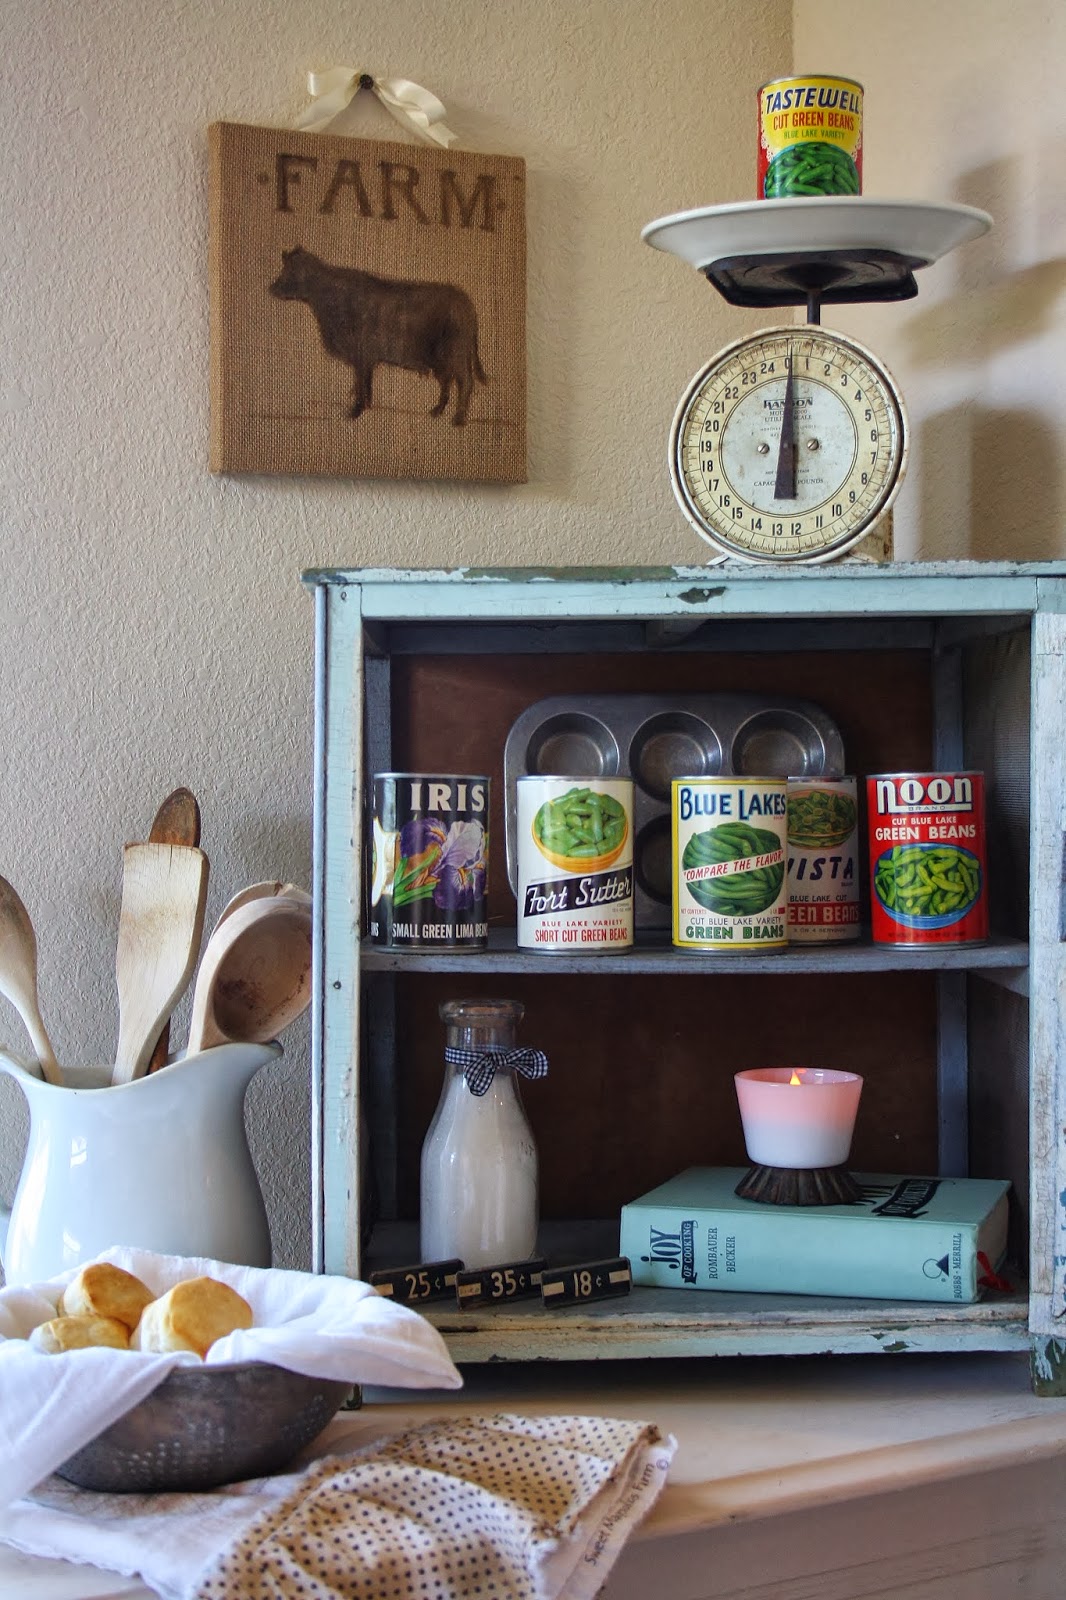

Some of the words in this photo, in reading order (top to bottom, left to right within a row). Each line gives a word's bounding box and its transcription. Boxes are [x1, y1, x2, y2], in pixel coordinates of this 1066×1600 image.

[766, 88, 859, 115] TASTEWELL
[773, 114, 789, 130] CUT
[792, 112, 824, 127] GREEN
[828, 112, 854, 131] BEANS
[784, 130, 798, 139] BLUE
[801, 129, 817, 138] LAKE
[820, 129, 845, 139] VARIETY
[275, 153, 496, 231] FARM
[761, 363, 775, 374] 24
[806, 359, 809, 370] 1
[824, 365, 831, 376] 2
[742, 372, 757, 384] 23
[841, 374, 847, 386] 3
[725, 387, 739, 399] 22
[854, 390, 862, 402] 4
[714, 402, 725, 414] 21
[865, 409, 872, 421] 5
[705, 421, 719, 432] 20
[870, 430, 877, 442] 6
[701, 440, 712, 452] 19
[870, 452, 877, 464] 7
[702, 460, 714, 472] 18
[861, 473, 868, 485] 8
[708, 479, 719, 492] 17
[719, 495, 730, 508] 16
[849, 491, 856, 503] 9
[732, 507, 743, 519] 15
[832, 504, 842, 517] 10
[751, 518, 762, 531] 14
[815, 516, 823, 527] 11
[772, 524, 783, 536] 13
[791, 523, 801, 535] 12
[410, 783, 485, 812] IRIS
[680, 787, 732, 821] BLUE
[738, 788, 786, 821] LAKES
[936, 816, 957, 824] LAKE
[876, 827, 919, 840] GREEN
[929, 825, 976, 839] BEANS
[734, 859, 751, 871] THE
[527, 886, 567, 913] Fort
[575, 876, 630, 905] Sutter
[788, 907, 817, 922] EEN
[823, 906, 859, 923] BEANS
[392, 923, 420, 938] SMALL
[422, 924, 452, 938] GREEN
[456, 923, 473, 938] LIMA
[535, 930, 558, 942] SHORT
[562, 930, 577, 942] CUT
[581, 929, 606, 941] GREEN
[610, 928, 627, 941] BEANS
[686, 926, 733, 939] GREEN
[743, 925, 784, 939] BEANS
[684, 1222, 692, 1263] COOKING
[707, 1227, 718, 1279] ROMBAUER
[725, 1236, 736, 1272] BECKER
[684, 1265, 692, 1277] OF
